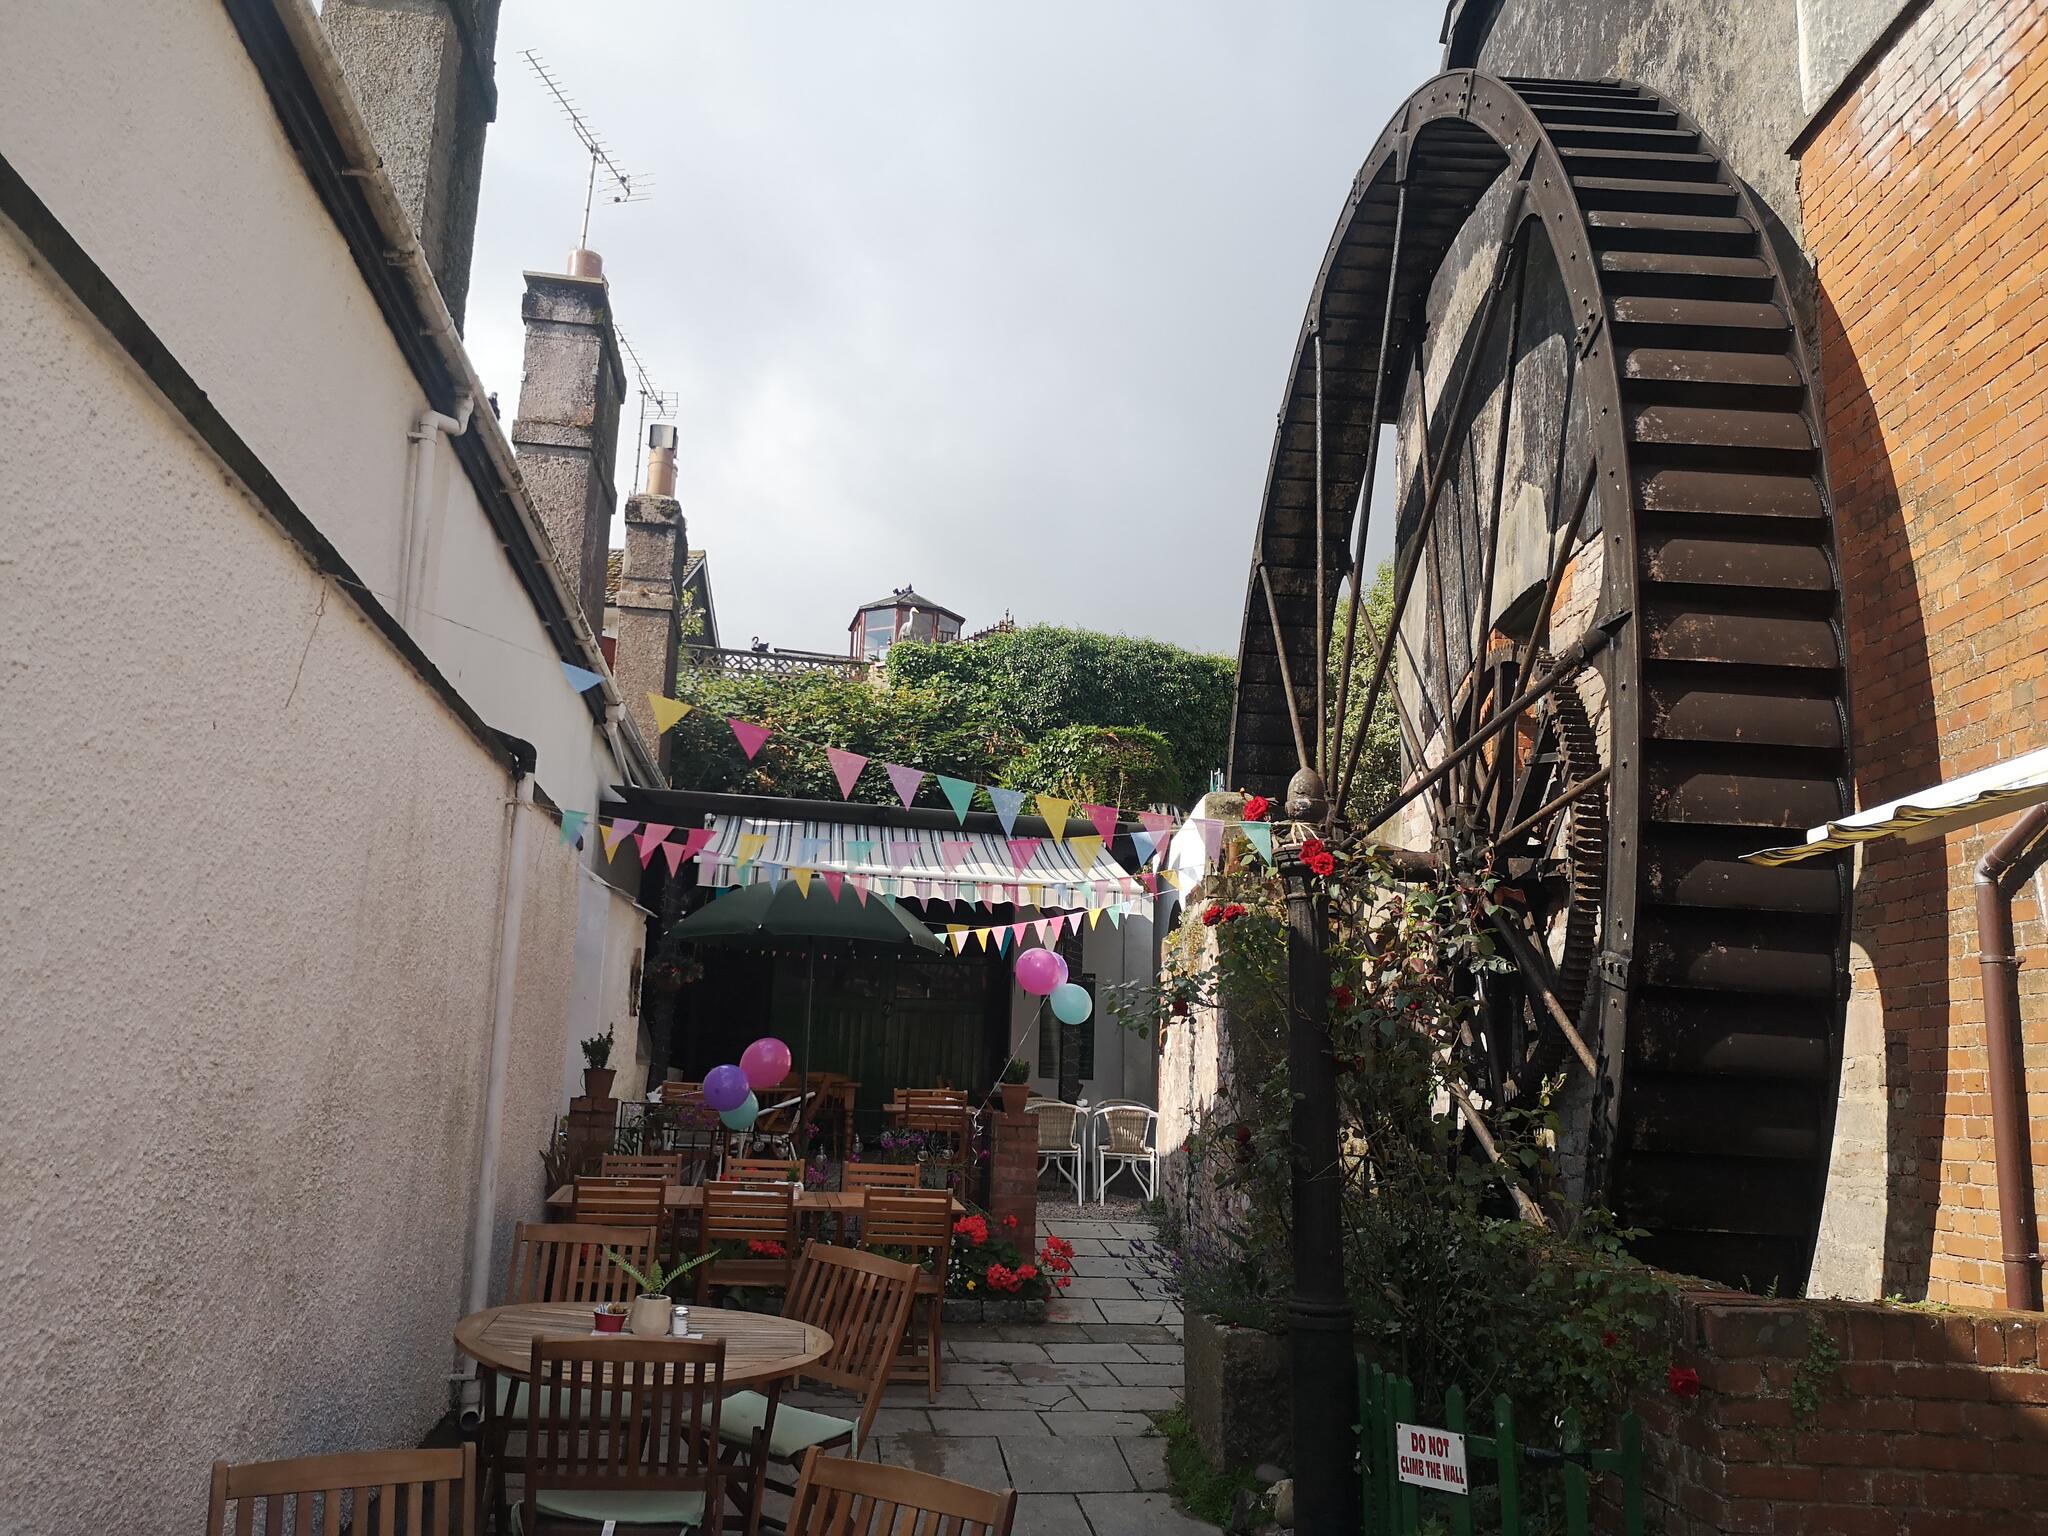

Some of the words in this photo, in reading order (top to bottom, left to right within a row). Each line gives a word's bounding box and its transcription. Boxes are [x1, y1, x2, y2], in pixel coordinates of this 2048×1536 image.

[1411, 1432, 1426, 1454] DO
[1428, 1435, 1449, 1458] NOT
[1400, 1455, 1424, 1477] CLIMB
[1425, 1460, 1442, 1480] THE
[1442, 1463, 1465, 1485] WALL
